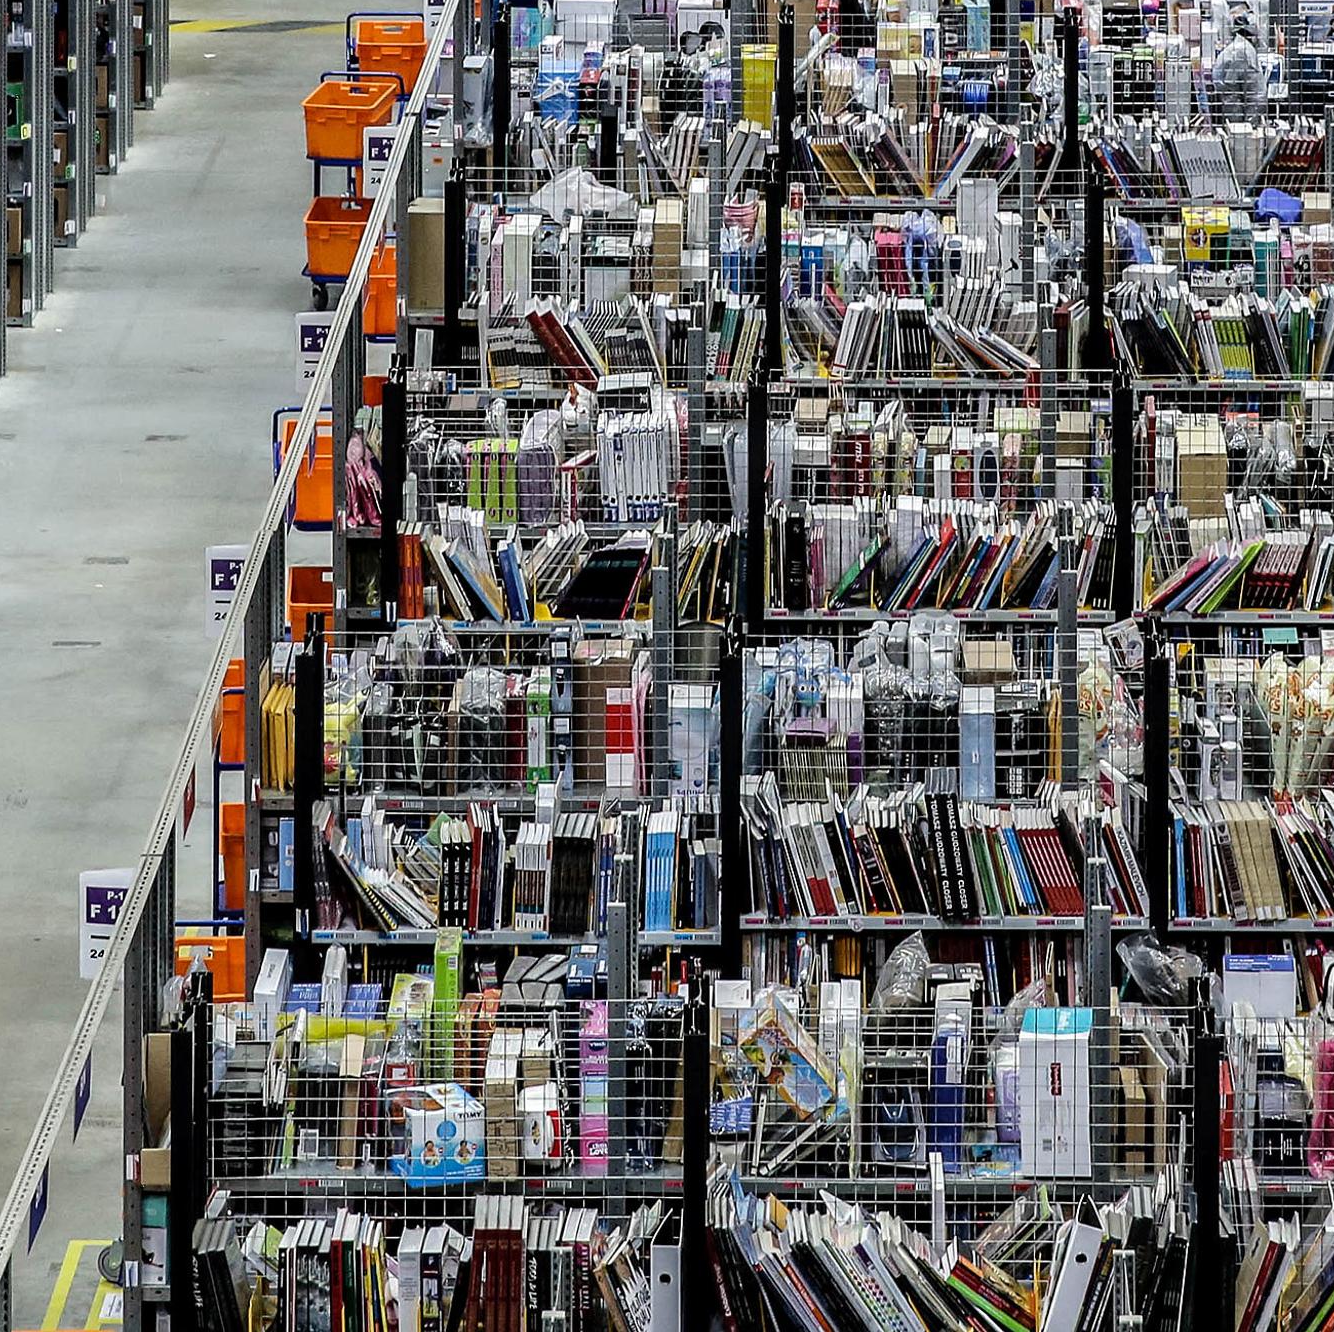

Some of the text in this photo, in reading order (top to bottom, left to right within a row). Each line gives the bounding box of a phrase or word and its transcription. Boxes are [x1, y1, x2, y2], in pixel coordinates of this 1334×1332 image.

[371, 148, 379, 158] F
[304, 337, 312, 348] F
[215, 573, 224, 586] F
[930, 799, 953, 909] TOMASZ GUDZOWATY CLOSER
[946, 799, 969, 909] TOMASZ GUDZOWATY CLOSER
[1116, 831, 1146, 897] KAZIMIR MALEVICH
[90, 904, 101, 919] F
[458, 1111, 482, 1119] TOMY
[581, 1246, 589, 1311] ANTONIO LOPEZ
[529, 1291, 538, 1309] LIFE
